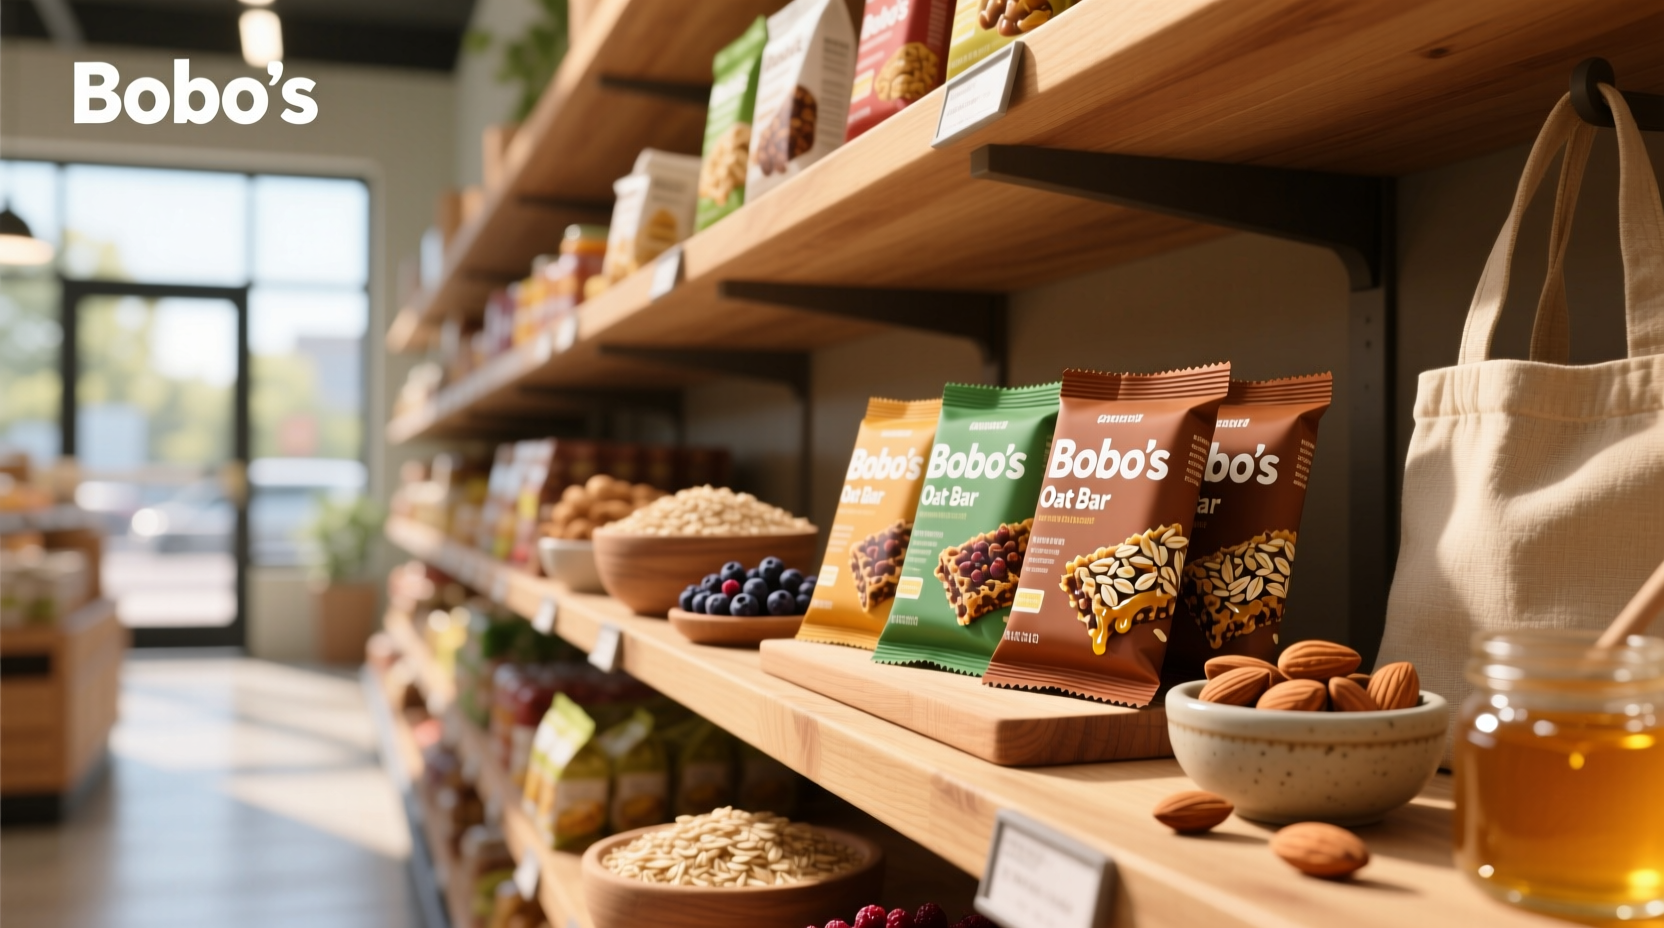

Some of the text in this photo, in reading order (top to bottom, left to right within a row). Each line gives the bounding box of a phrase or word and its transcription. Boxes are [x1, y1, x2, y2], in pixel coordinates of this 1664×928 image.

[846, 447, 924, 480] Bobo's
[926, 443, 1027, 480] Bobo's
[1048, 438, 1170, 481] Bobo's
[1204, 441, 1280, 485] bo's
[921, 485, 979, 507] Oat Bar
[1039, 485, 1112, 511] Oat Bar
[1196, 497, 1221, 514] ar
